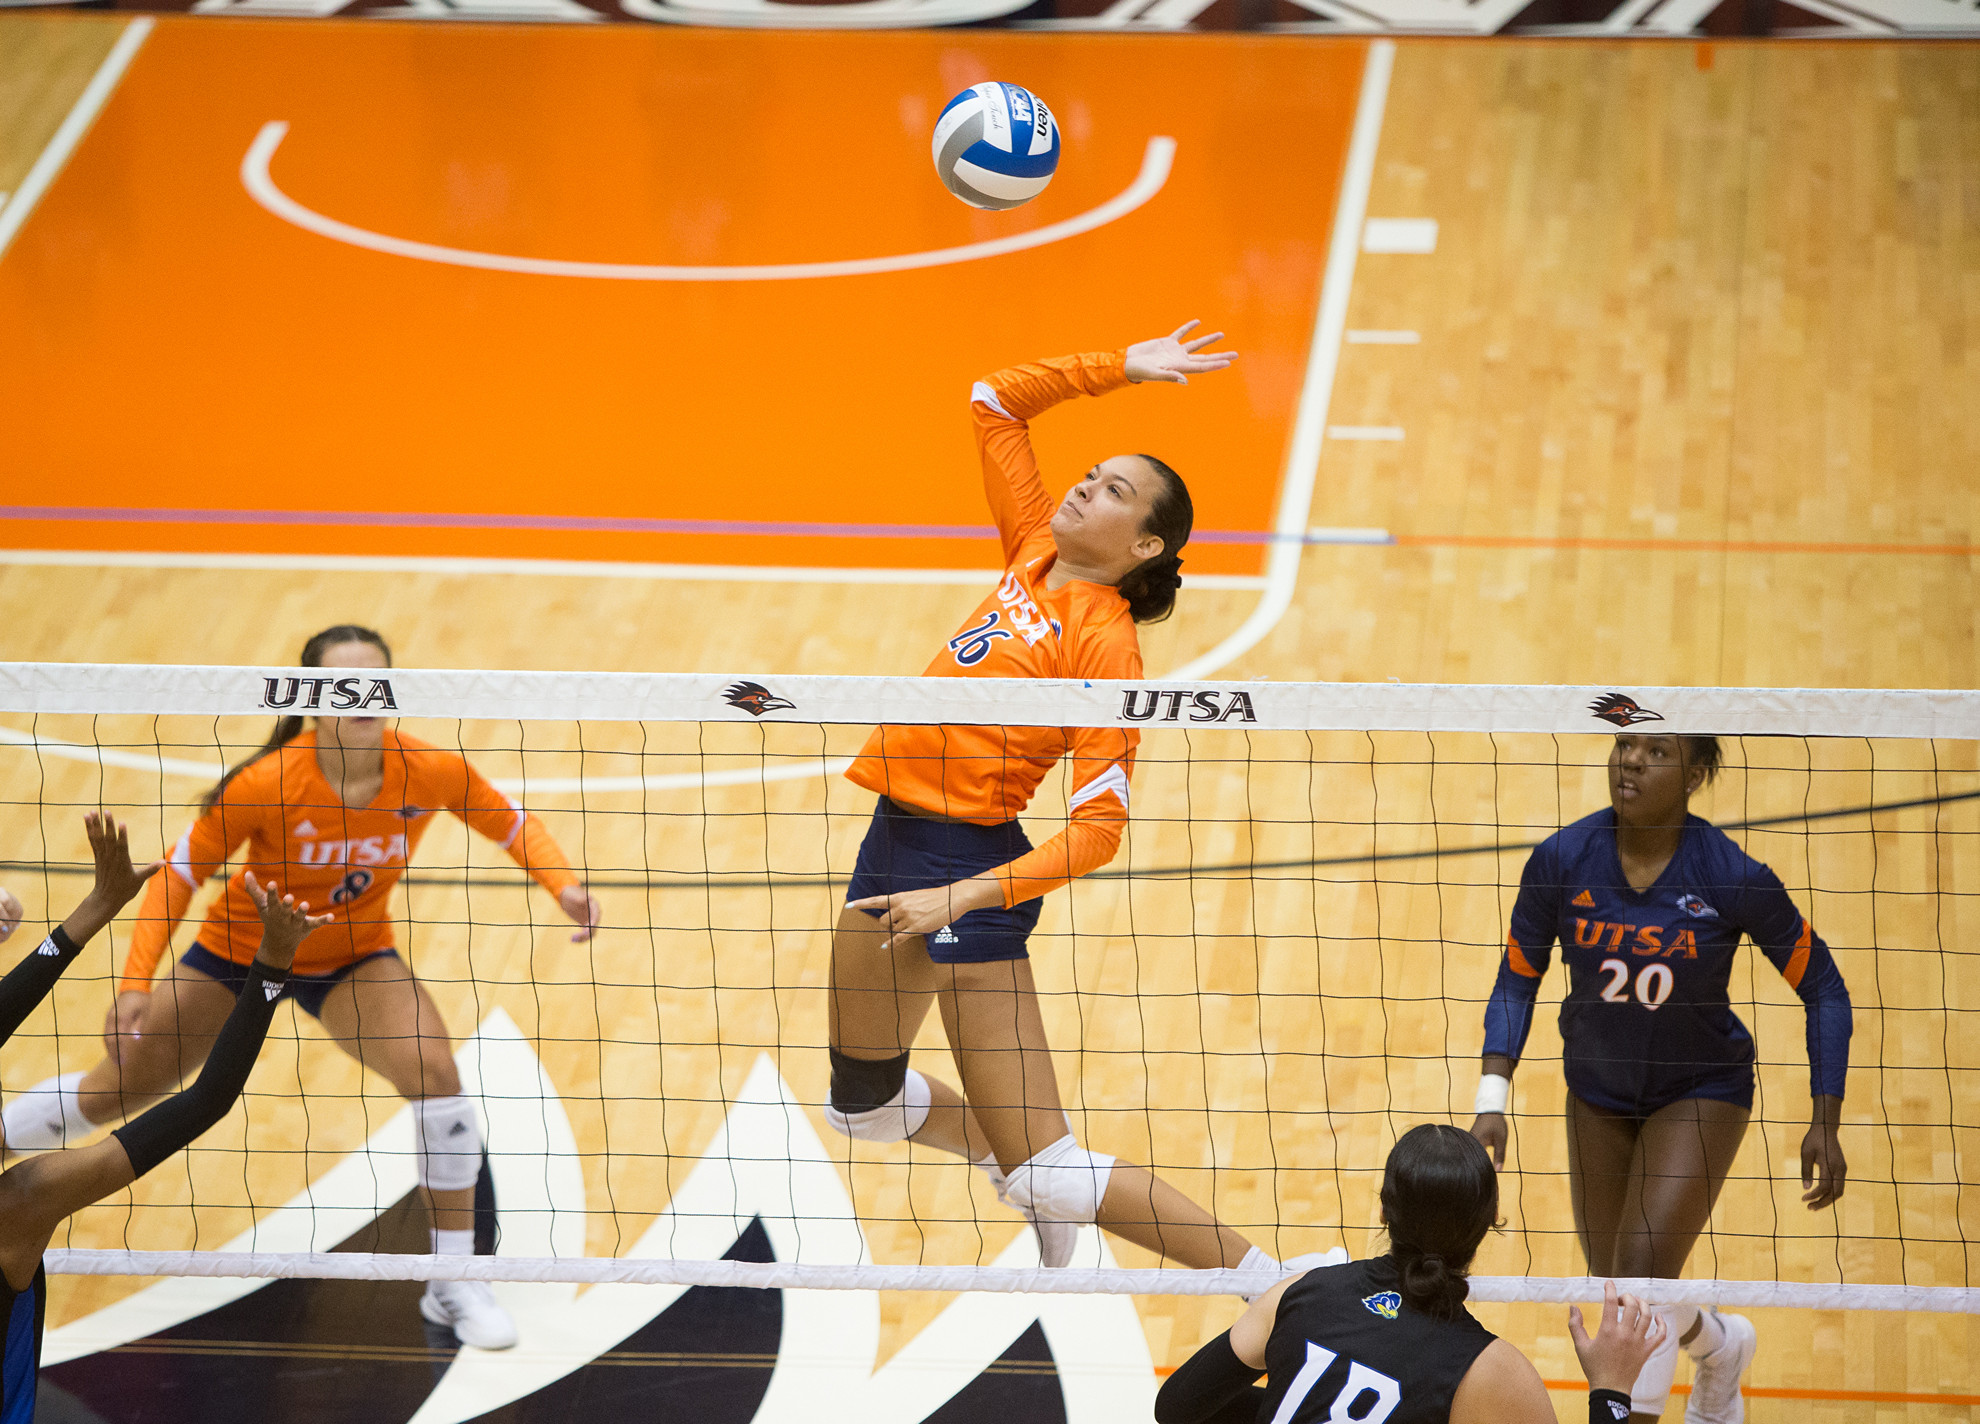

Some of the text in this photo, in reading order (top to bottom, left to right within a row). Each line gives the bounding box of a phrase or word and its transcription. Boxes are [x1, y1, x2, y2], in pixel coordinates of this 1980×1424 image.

[997, 571, 1050, 648] UTSA
[947, 610, 1015, 667] 26
[263, 677, 399, 710] UTSA
[1121, 689, 1258, 722] UTSA
[299, 833, 408, 870] UTSA
[1574, 917, 1698, 959] UTSA
[1599, 958, 1674, 1012] 20
